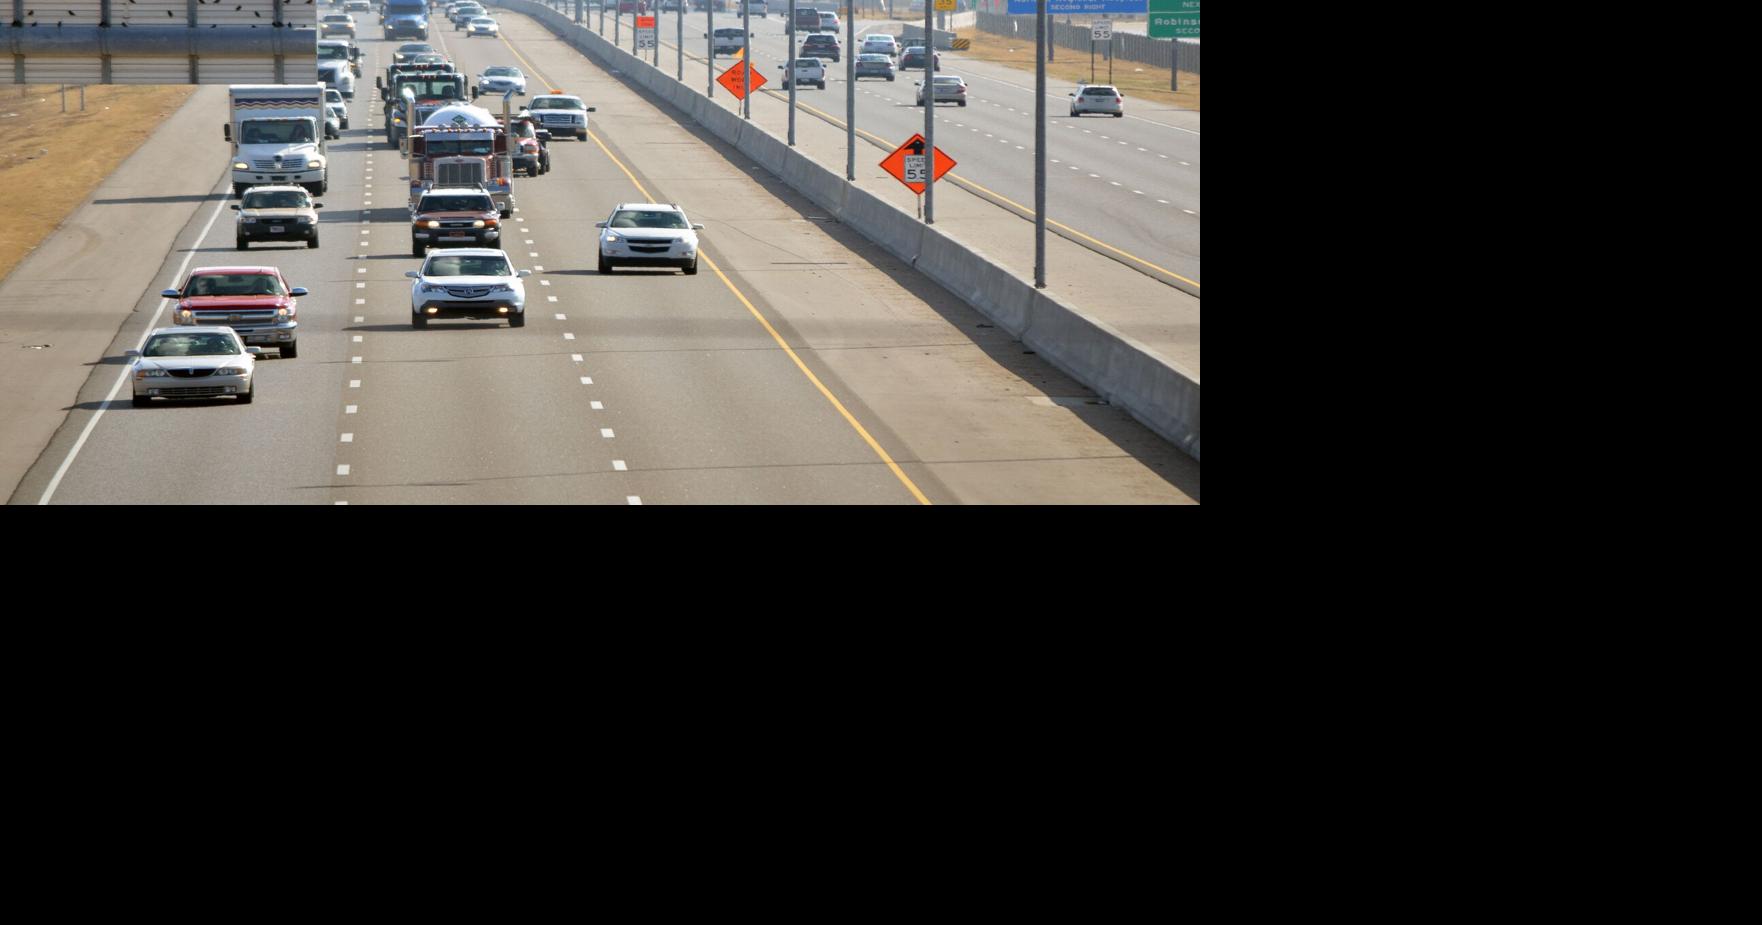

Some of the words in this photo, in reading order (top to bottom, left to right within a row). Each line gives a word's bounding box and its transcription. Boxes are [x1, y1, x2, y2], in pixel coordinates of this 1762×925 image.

[1154, 18, 1200, 26] Robins
[1094, 30, 1110, 39] 55
[639, 40, 656, 48] 55
[907, 169, 926, 179] 55
